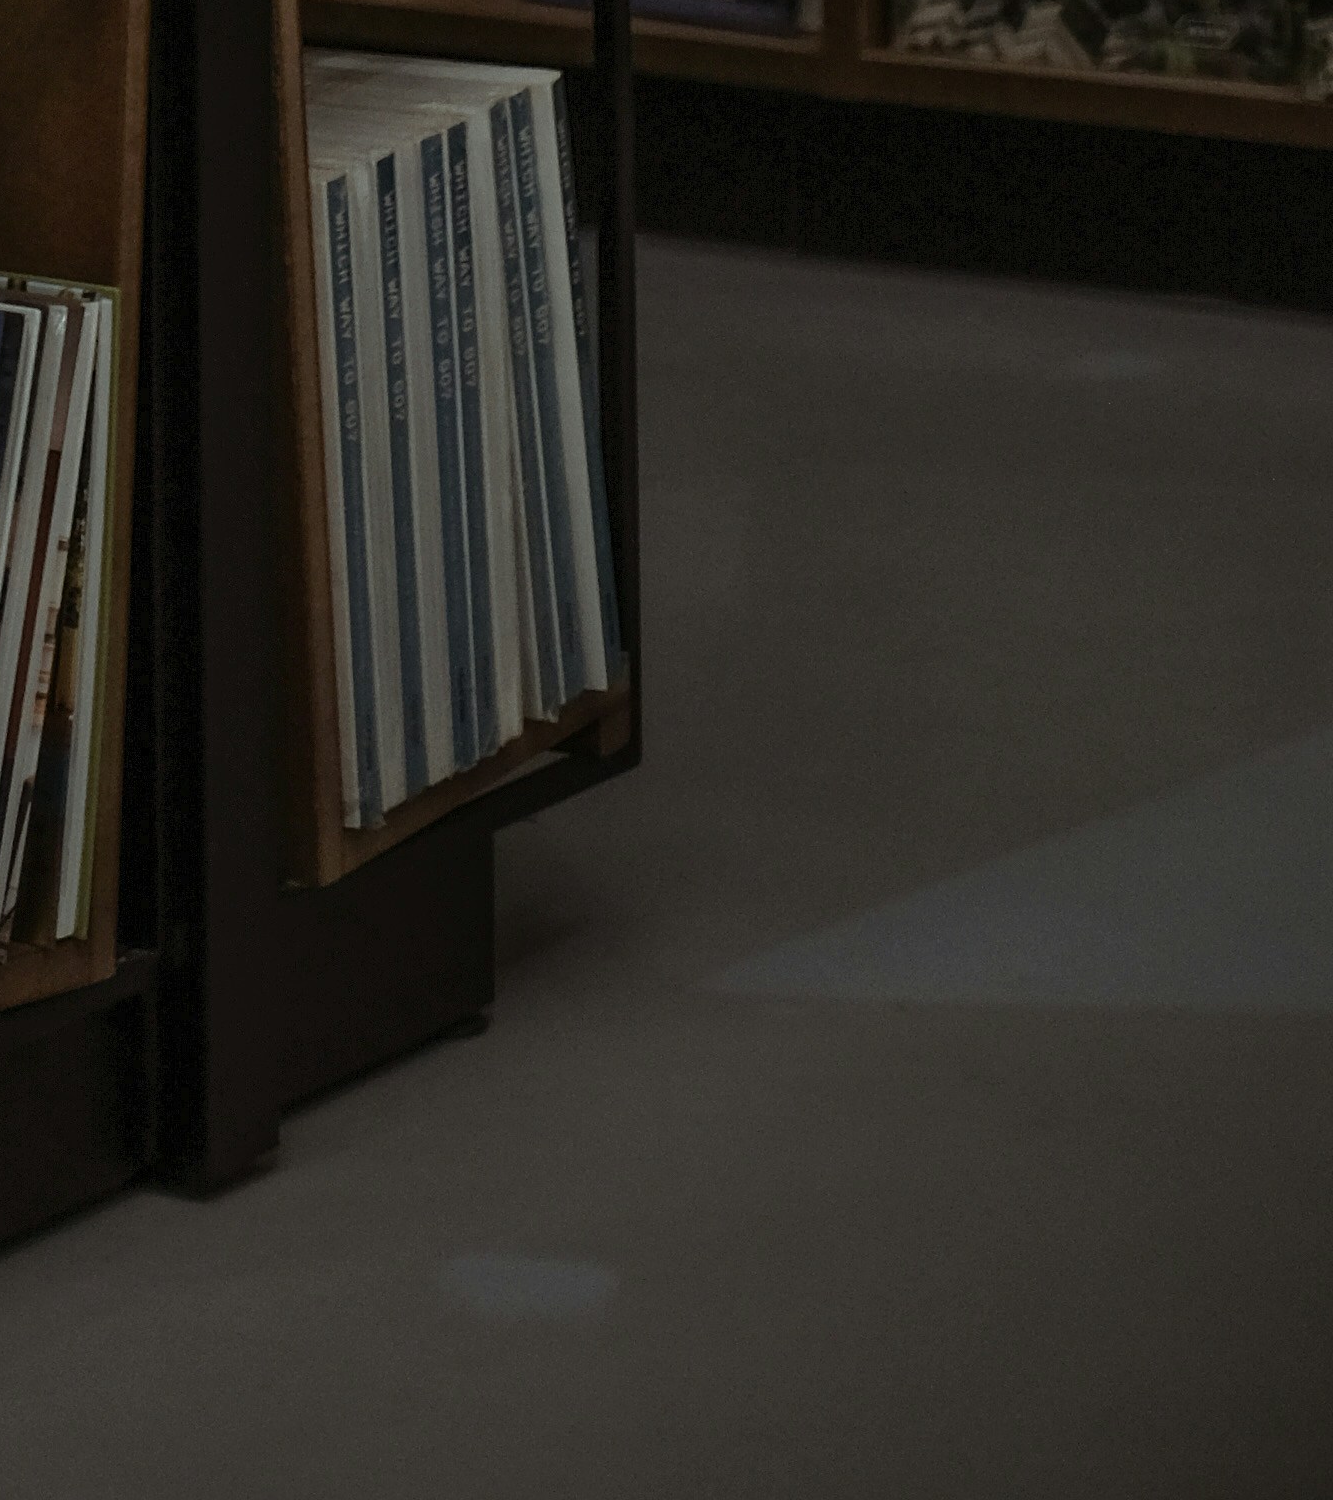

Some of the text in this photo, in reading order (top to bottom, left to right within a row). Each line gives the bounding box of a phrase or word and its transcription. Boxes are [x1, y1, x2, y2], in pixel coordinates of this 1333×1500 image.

[452, 160, 469, 233] WHICH
[382, 191, 399, 265] WHICH
[434, 258, 449, 299] WAY
[457, 249, 472, 287] WAY
[388, 280, 403, 320] WAY
[436, 319, 451, 344] TO
